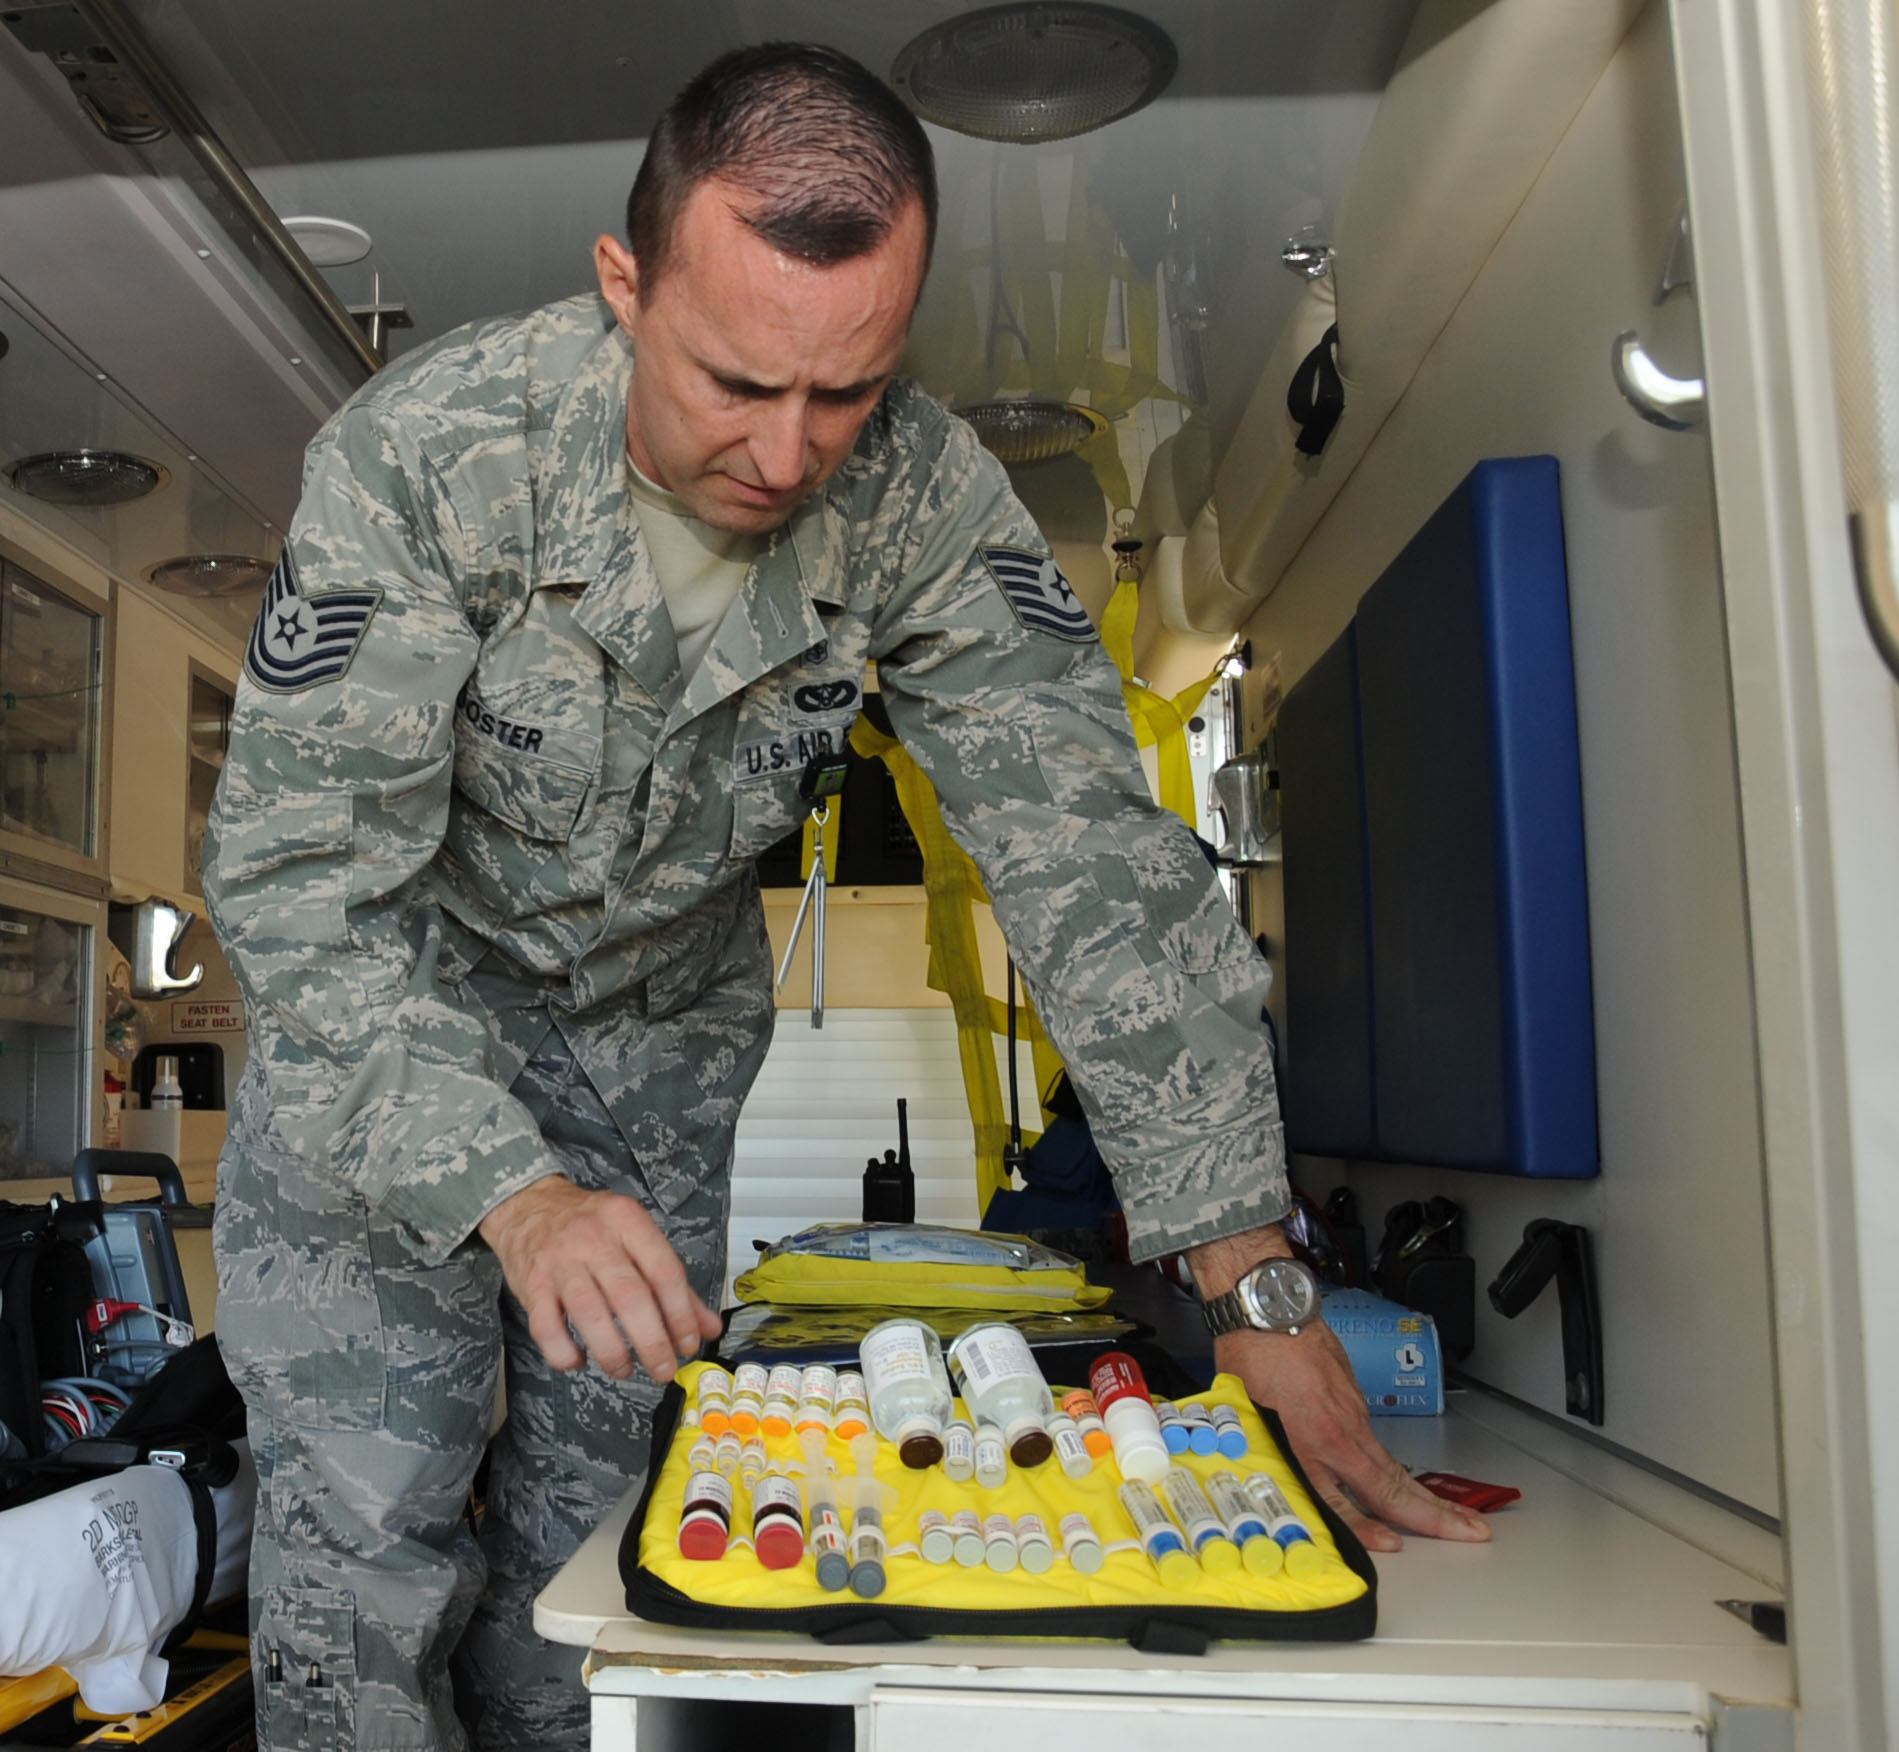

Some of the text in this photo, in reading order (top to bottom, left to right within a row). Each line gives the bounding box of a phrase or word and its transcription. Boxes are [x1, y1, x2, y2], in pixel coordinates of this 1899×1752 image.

[746, 742, 791, 774] U.S.
[188, 1005, 230, 1015] FASTEN
[180, 1017, 238, 1029] SEAT BELT
[1397, 1318, 1424, 1334] SE
[1405, 1350, 1415, 1364] L
